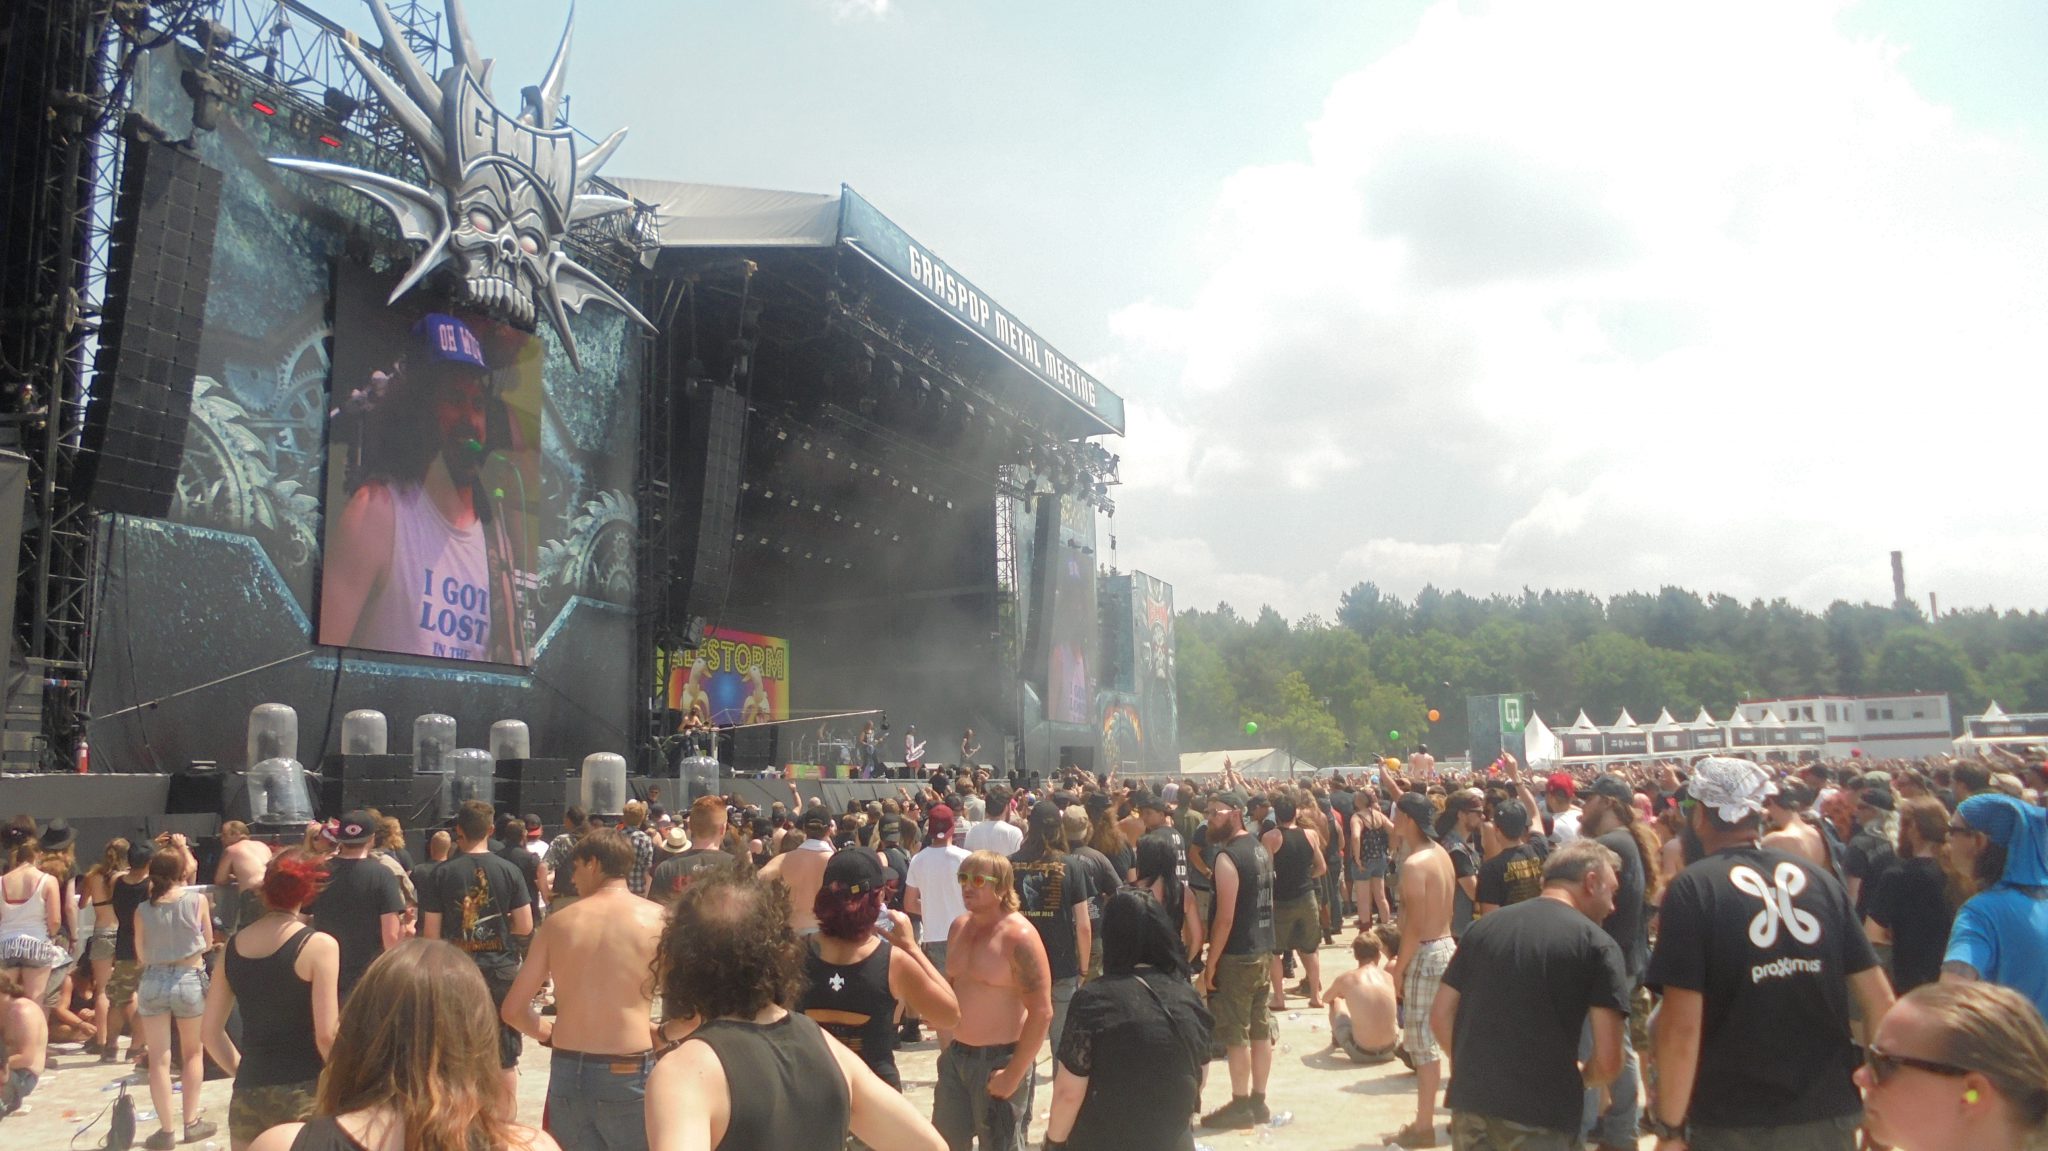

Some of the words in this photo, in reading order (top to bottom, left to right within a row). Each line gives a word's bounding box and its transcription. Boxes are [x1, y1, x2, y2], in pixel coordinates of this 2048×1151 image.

[462, 81, 574, 222] GMM
[908, 244, 990, 328] GRASPOP
[995, 310, 1041, 369] METAL
[1044, 348, 1096, 408] MEETING
[424, 568, 434, 597] I
[442, 576, 488, 615] GOT
[419, 601, 489, 645] LOST
[432, 642, 446, 658] IN
[448, 646, 472, 660] THE
[1751, 957, 1821, 984] proximus
